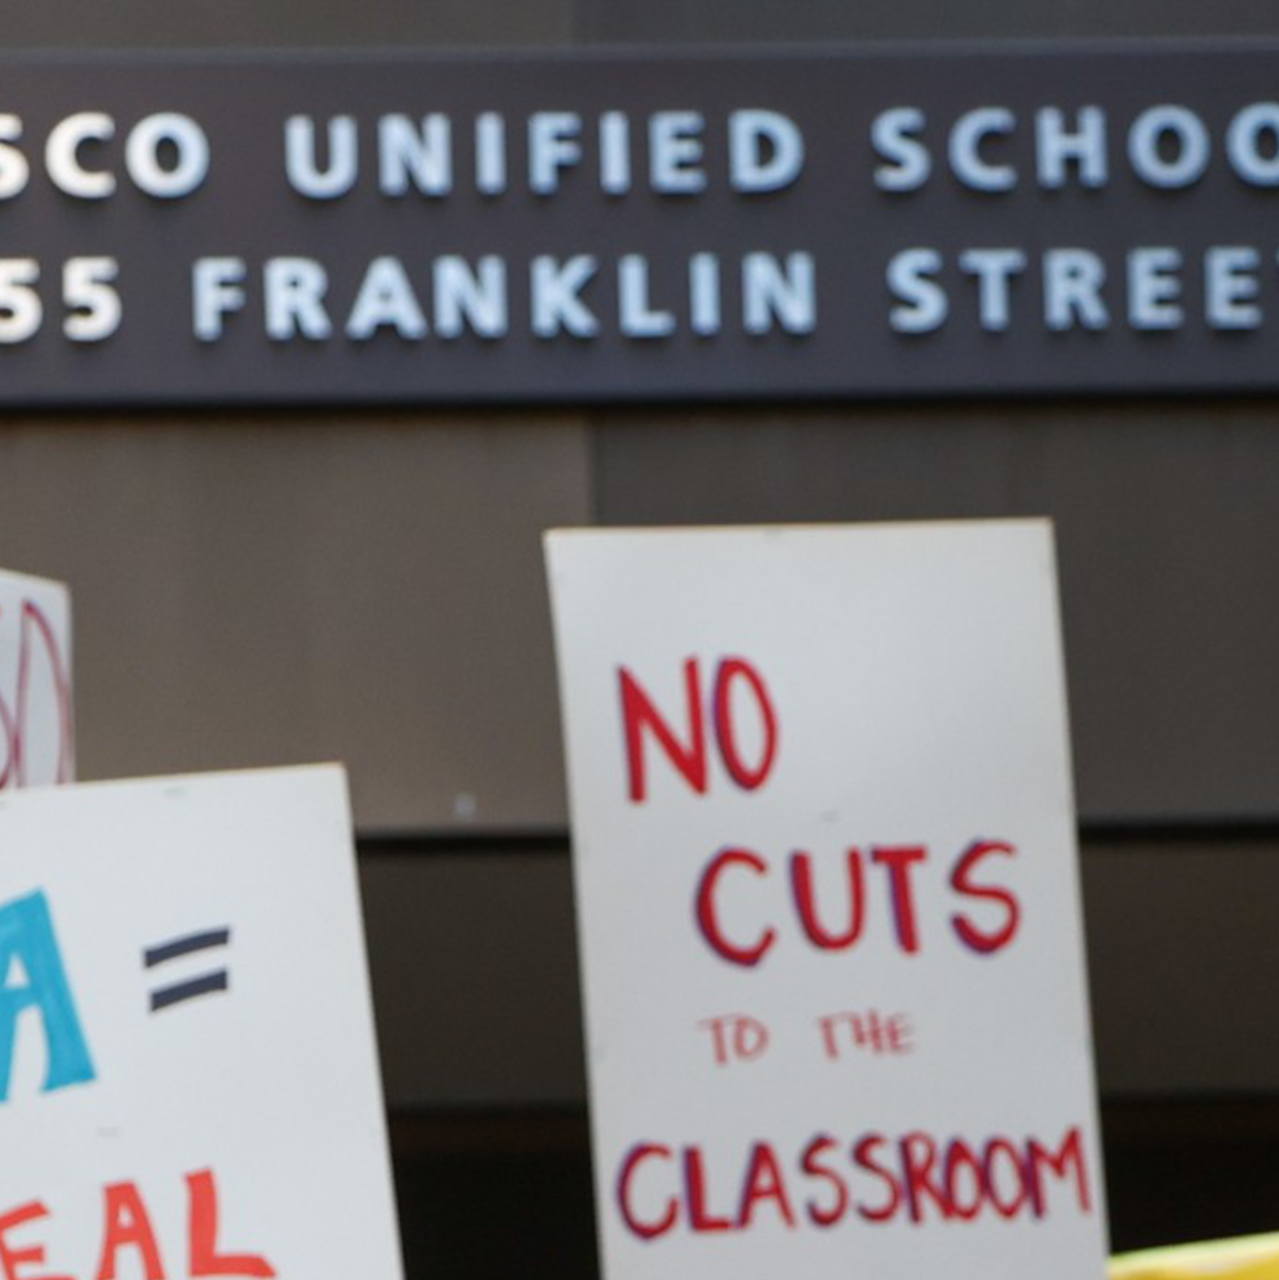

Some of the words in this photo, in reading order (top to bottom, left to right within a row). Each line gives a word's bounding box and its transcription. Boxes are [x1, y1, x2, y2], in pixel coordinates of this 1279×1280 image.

[286, 111, 800, 195] UNIFIED
[194, 254, 812, 336] FRANKLIN
[618, 657, 778, 803] NO
[694, 841, 1019, 968] CUTS
[143, 928, 230, 1012] =
[701, 1013, 770, 1067] TO
[818, 1009, 916, 1061] THE
[616, 1128, 1089, 1241] CLASSROOM
